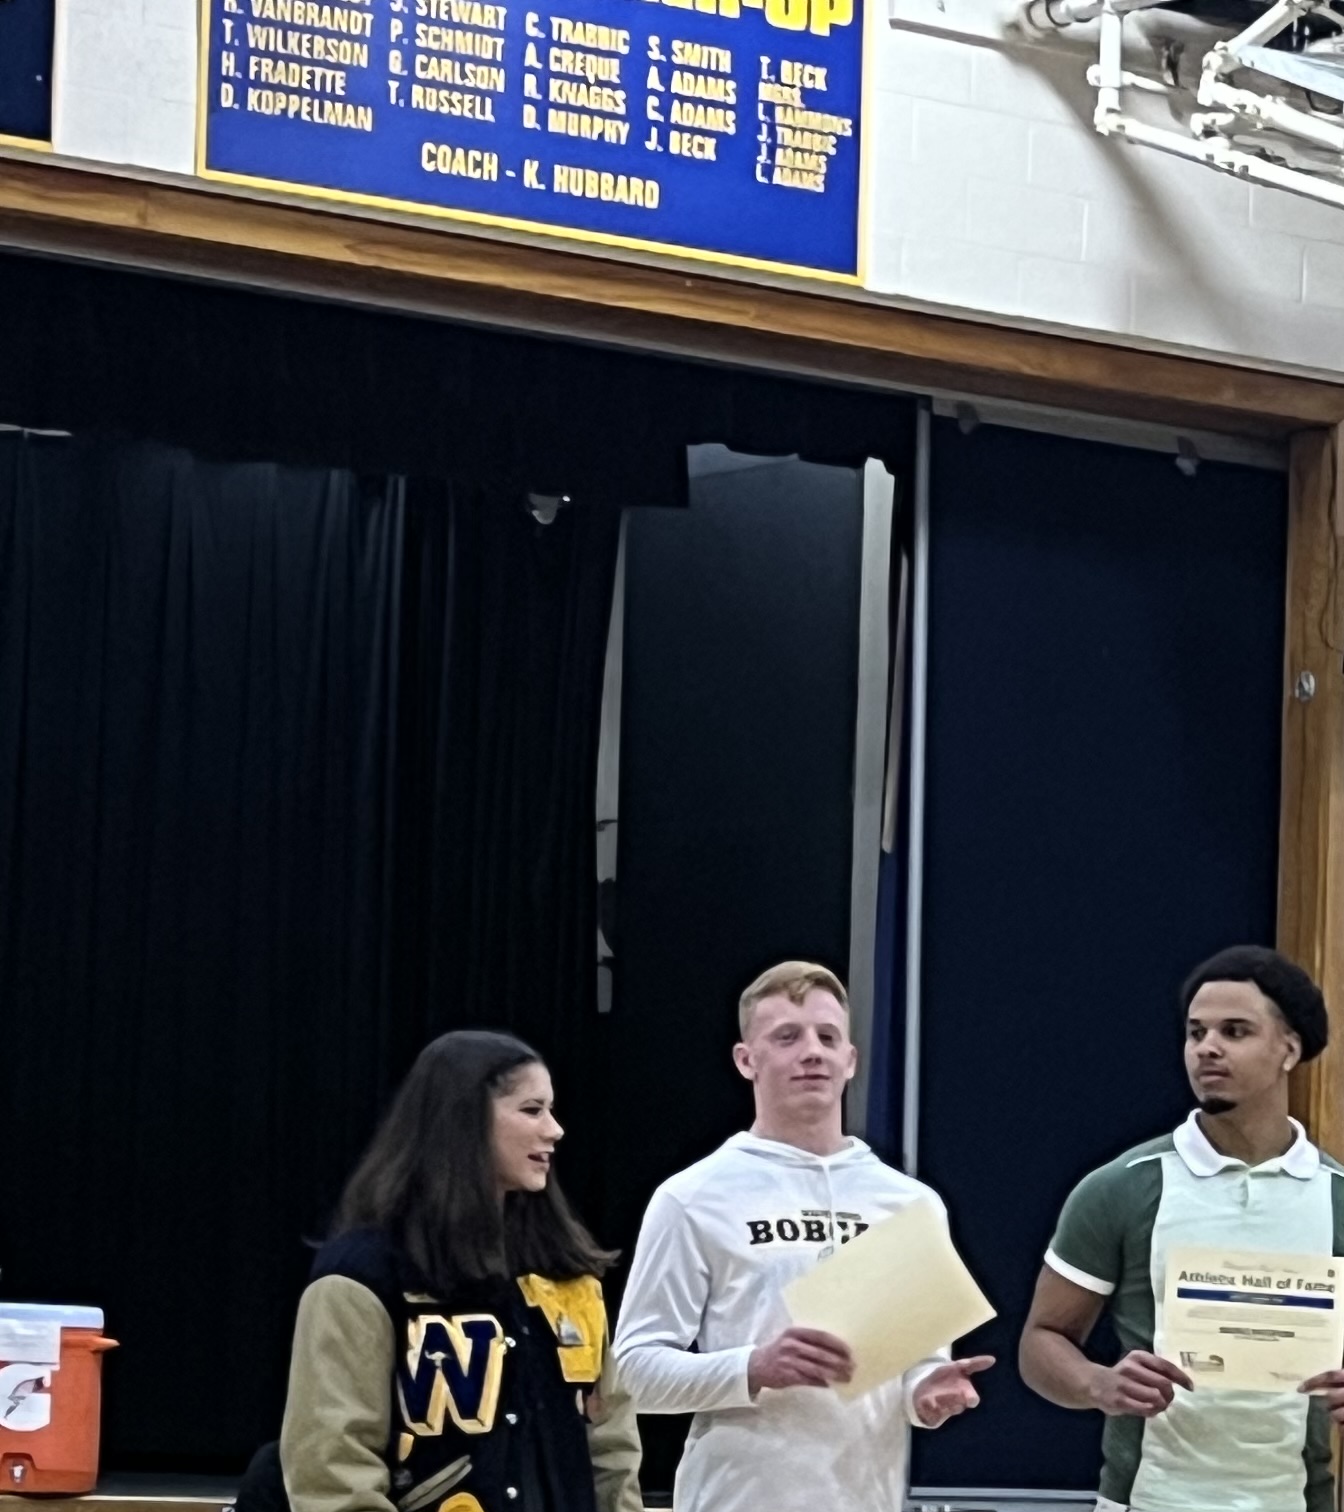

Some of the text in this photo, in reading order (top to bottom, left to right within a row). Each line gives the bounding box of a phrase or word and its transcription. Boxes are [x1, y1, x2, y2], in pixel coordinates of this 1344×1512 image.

[222, 19, 239, 46] T.
[390, 18, 505, 61] P. SCHMIDT
[221, 51, 346, 96] H. FRADETTE
[415, 54, 505, 92] CARLSON
[671, 40, 732, 73] SMITH
[388, 80, 405, 107] T.
[671, 70, 736, 104] ADAMS
[220, 82, 373, 132] D. KOPPELMAN
[670, 100, 736, 135] ADAMS
[548, 108, 630, 145] MURPHY
[421, 142, 499, 182] COACH
[523, 159, 546, 190] K.
[553, 164, 660, 209] HUBBARD
[398, 1315, 505, 1436] W
